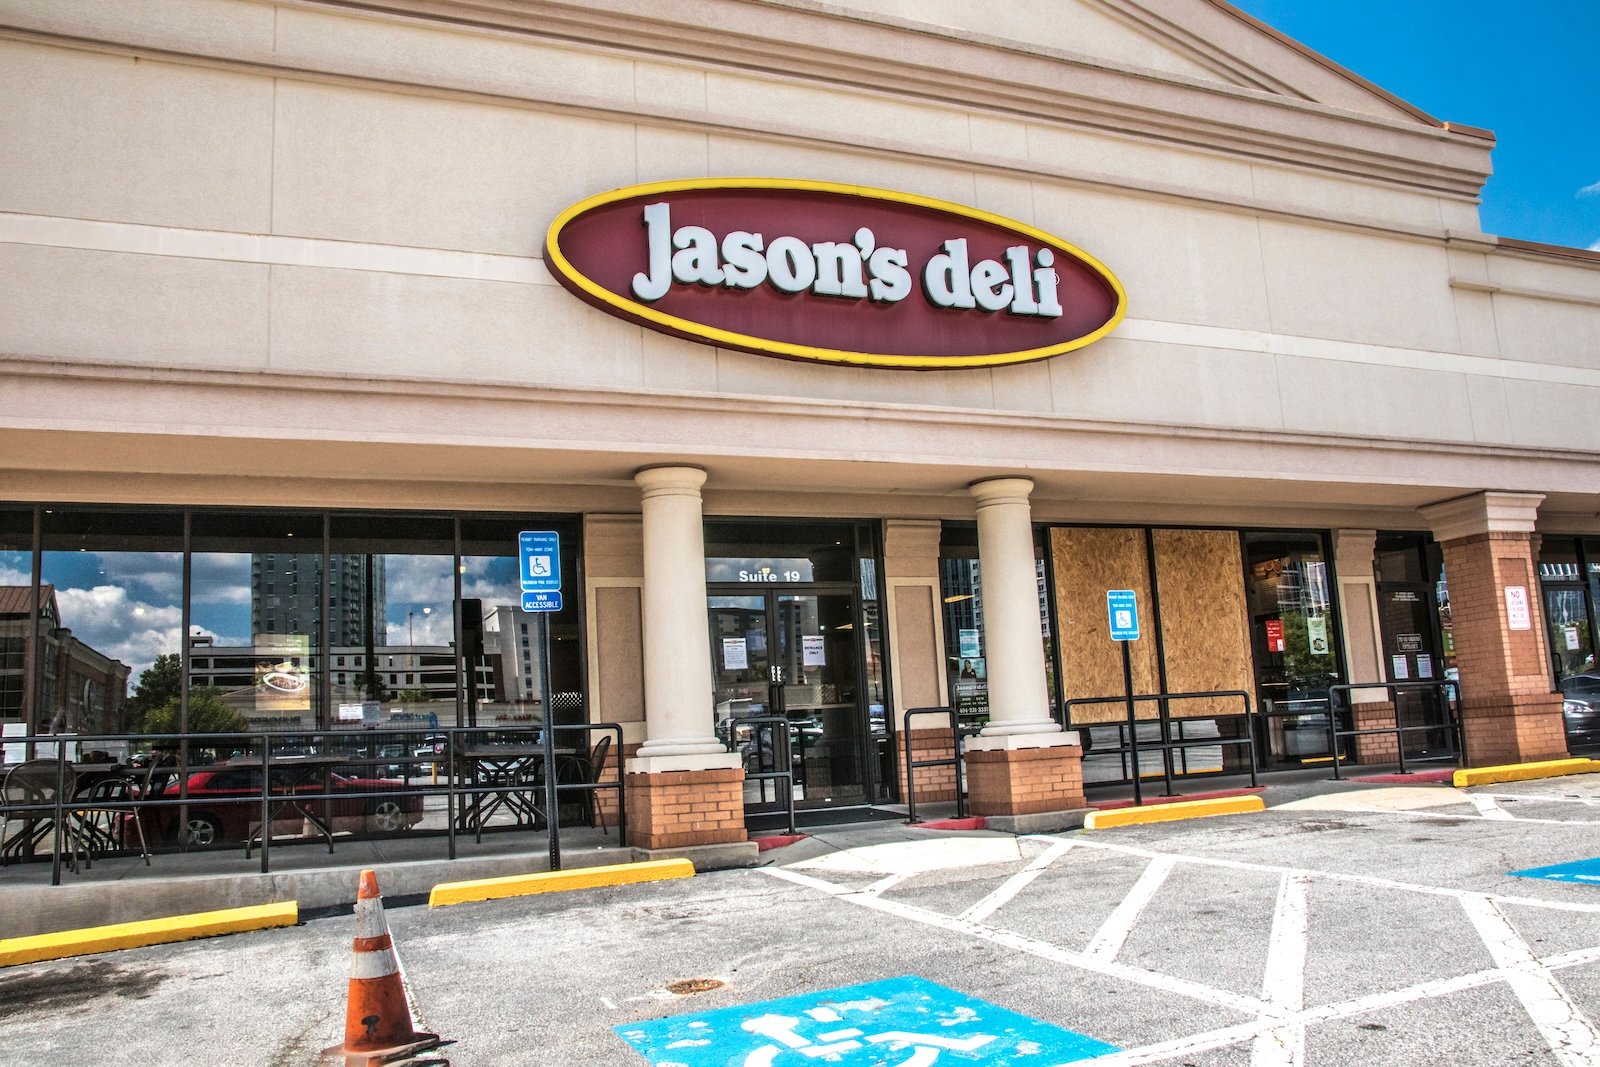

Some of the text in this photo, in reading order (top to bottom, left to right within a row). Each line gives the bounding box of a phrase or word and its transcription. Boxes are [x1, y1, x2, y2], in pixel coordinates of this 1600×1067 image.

[631, 202, 1063, 317] Jason's deli
[739, 570, 800, 582] Suite 19
[525, 601, 559, 609] ACCESSIBLE
